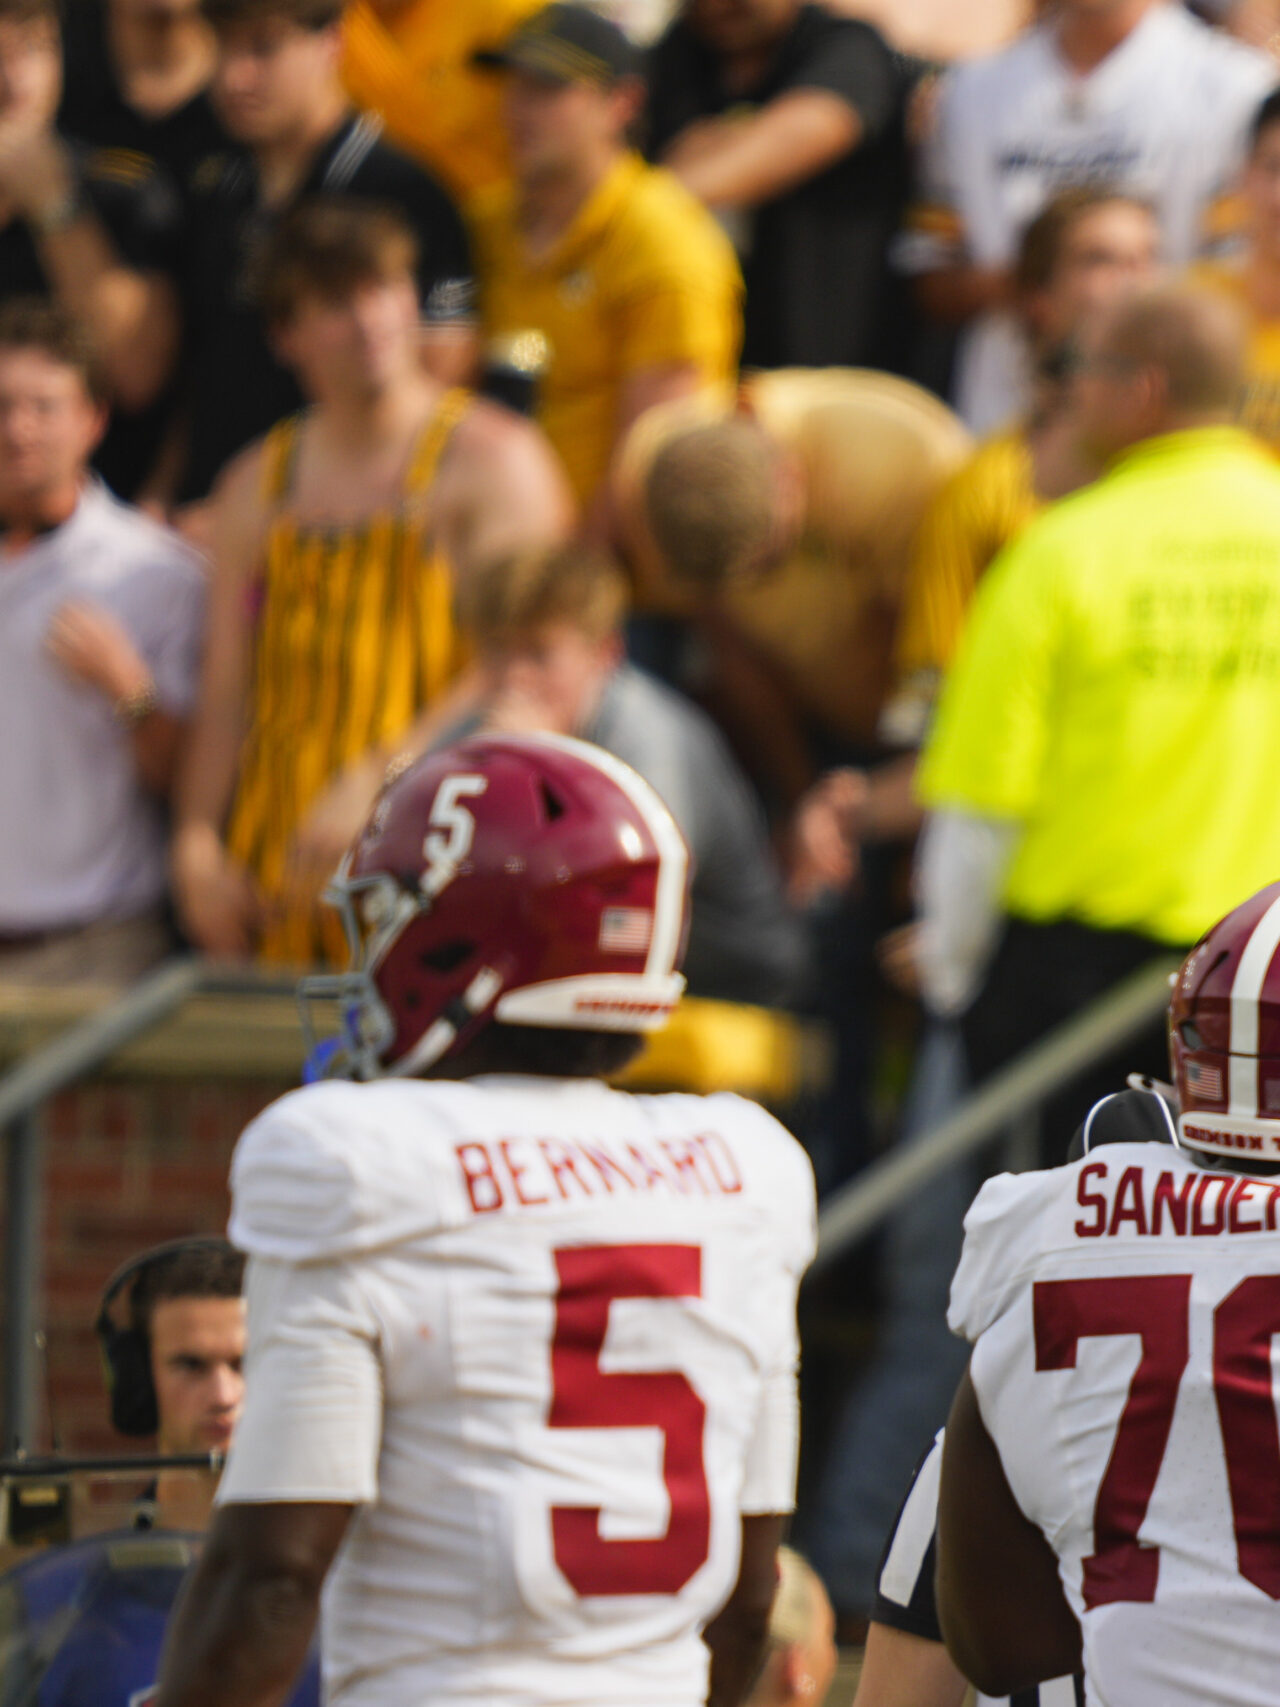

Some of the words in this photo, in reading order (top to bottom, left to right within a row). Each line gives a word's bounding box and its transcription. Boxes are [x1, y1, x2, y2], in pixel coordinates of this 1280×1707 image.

[423, 773, 489, 866] 5
[454, 1131, 743, 1213] BERNARD
[1184, 1125, 1263, 1150] CRIMSON
[546, 1243, 711, 1597] 5
